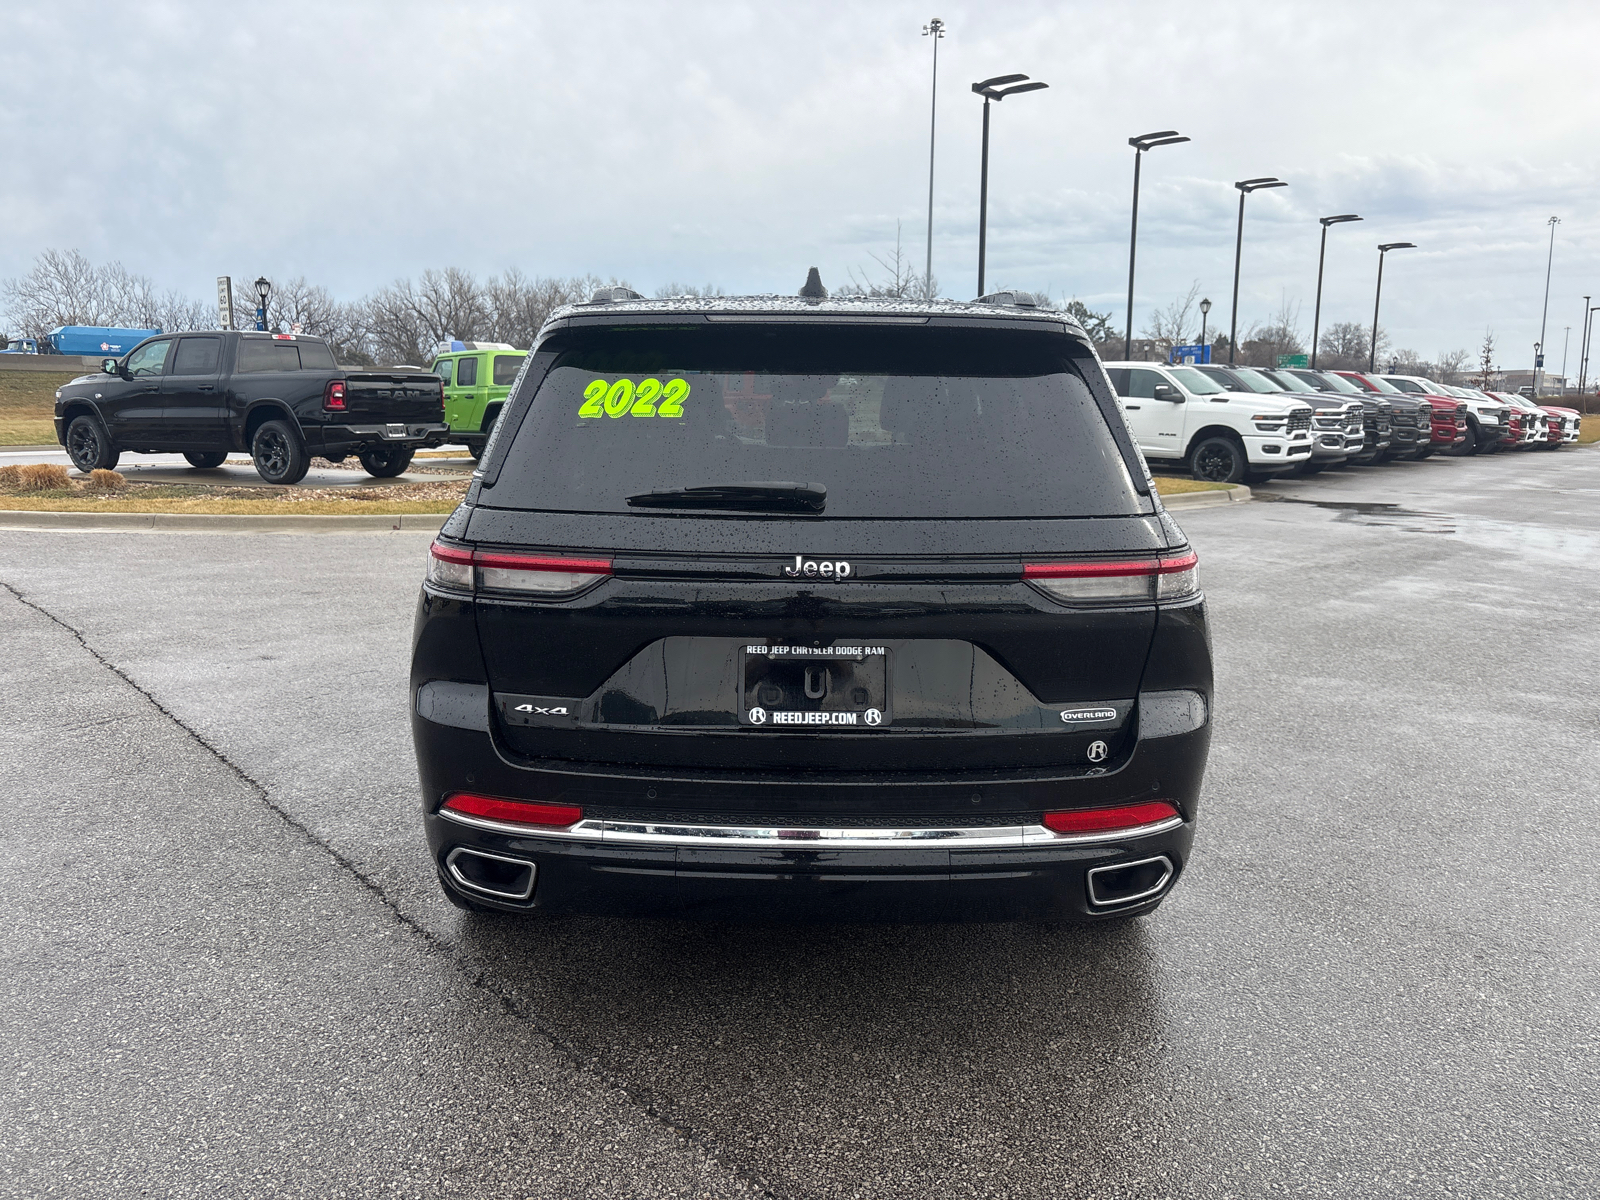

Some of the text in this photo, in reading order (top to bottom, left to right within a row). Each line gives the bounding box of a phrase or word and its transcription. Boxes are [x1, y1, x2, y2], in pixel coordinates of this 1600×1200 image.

[377, 390, 420, 398] RAM
[578, 378, 690, 418] 2022
[785, 556, 851, 581] Jeep
[746, 645, 885, 655] REED JEEP CHRYSLER DODGE RAM
[514, 704, 569, 715] 4x4
[773, 711, 857, 725] REEDJEEP.COM
[1064, 711, 1114, 720] OVERLAND
